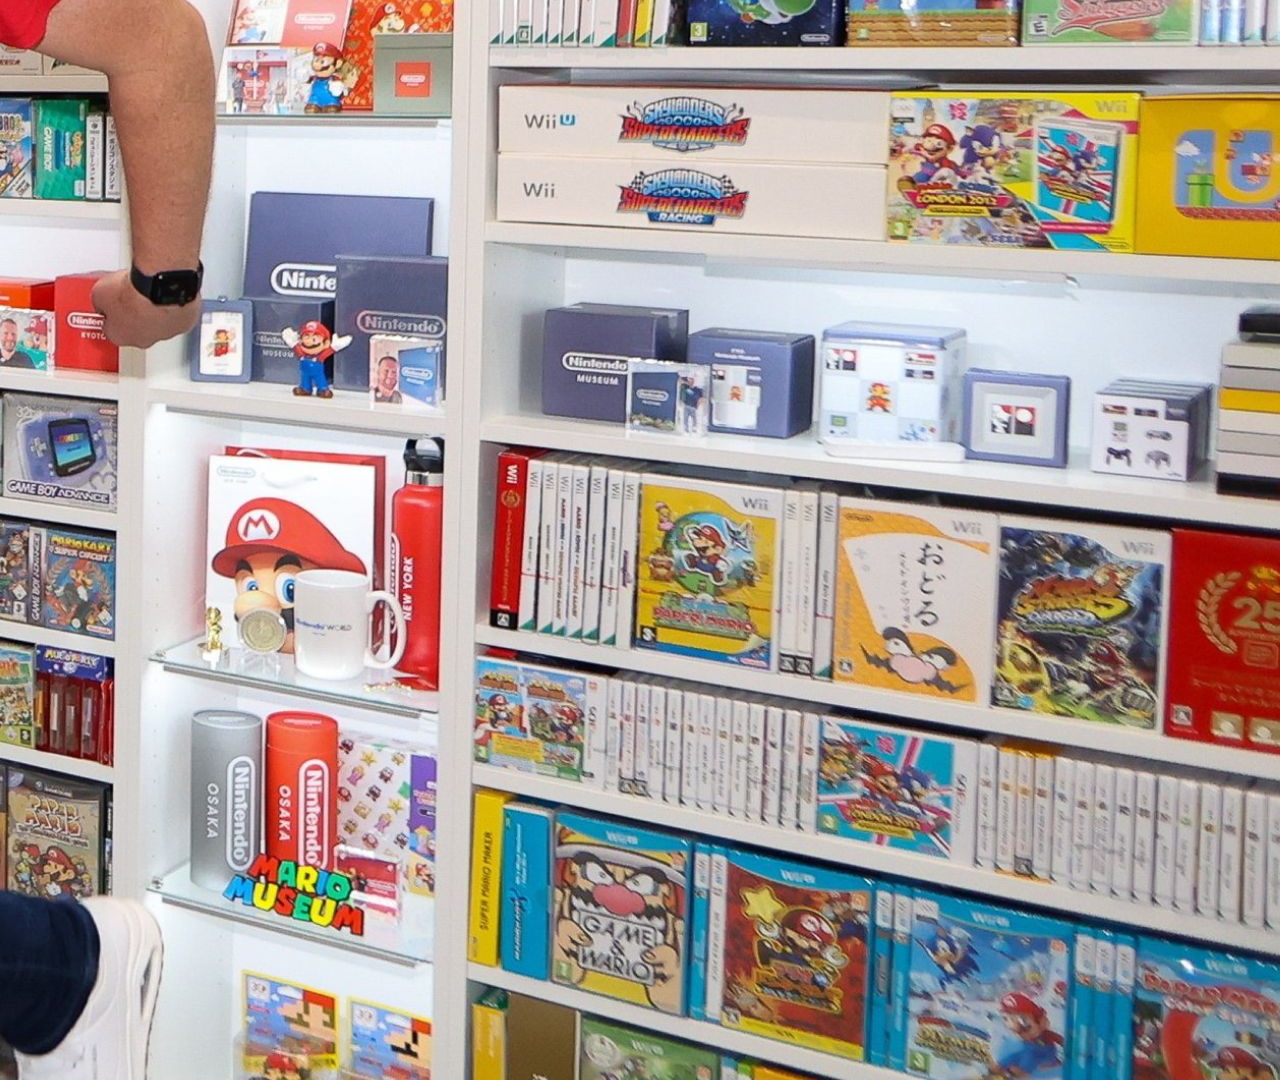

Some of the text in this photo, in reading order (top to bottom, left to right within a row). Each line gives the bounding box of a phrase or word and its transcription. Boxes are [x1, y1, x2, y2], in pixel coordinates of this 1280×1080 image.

[644, 96, 725, 126] SKYLANDERS
[1095, 100, 1128, 113] Wii
[525, 113, 557, 130] Wii
[618, 117, 751, 145] SUPERCHARGERS
[524, 182, 556, 198] Wii
[642, 169, 723, 198] SKYLANDERS
[657, 212, 706, 224] RACING
[282, 270, 337, 290] Ninte
[363, 315, 439, 334] Nintendo
[568, 356, 627, 371] Nintendo
[575, 374, 620, 387] MUSEUM
[507, 464, 518, 485] Wii
[7, 480, 110, 504] GAME BOY ADVANCE
[741, 495, 769, 511] Wii
[243, 514, 274, 538] M
[950, 519, 982, 536] Wii
[1121, 540, 1154, 557] Wii
[403, 556, 414, 622] NEW YORK
[325, 623, 352, 632] WORLD
[206, 782, 220, 839] OSAKA
[233, 766, 250, 862] Nintendo
[278, 784, 292, 841] OSAKA
[305, 769, 324, 866] Nintendo
[247, 852, 354, 902] MARIO
[480, 831, 495, 933] SUPER MARIO MAKER
[222, 873, 365, 937] MUSEUM
[577, 946, 651, 980] WARIO
